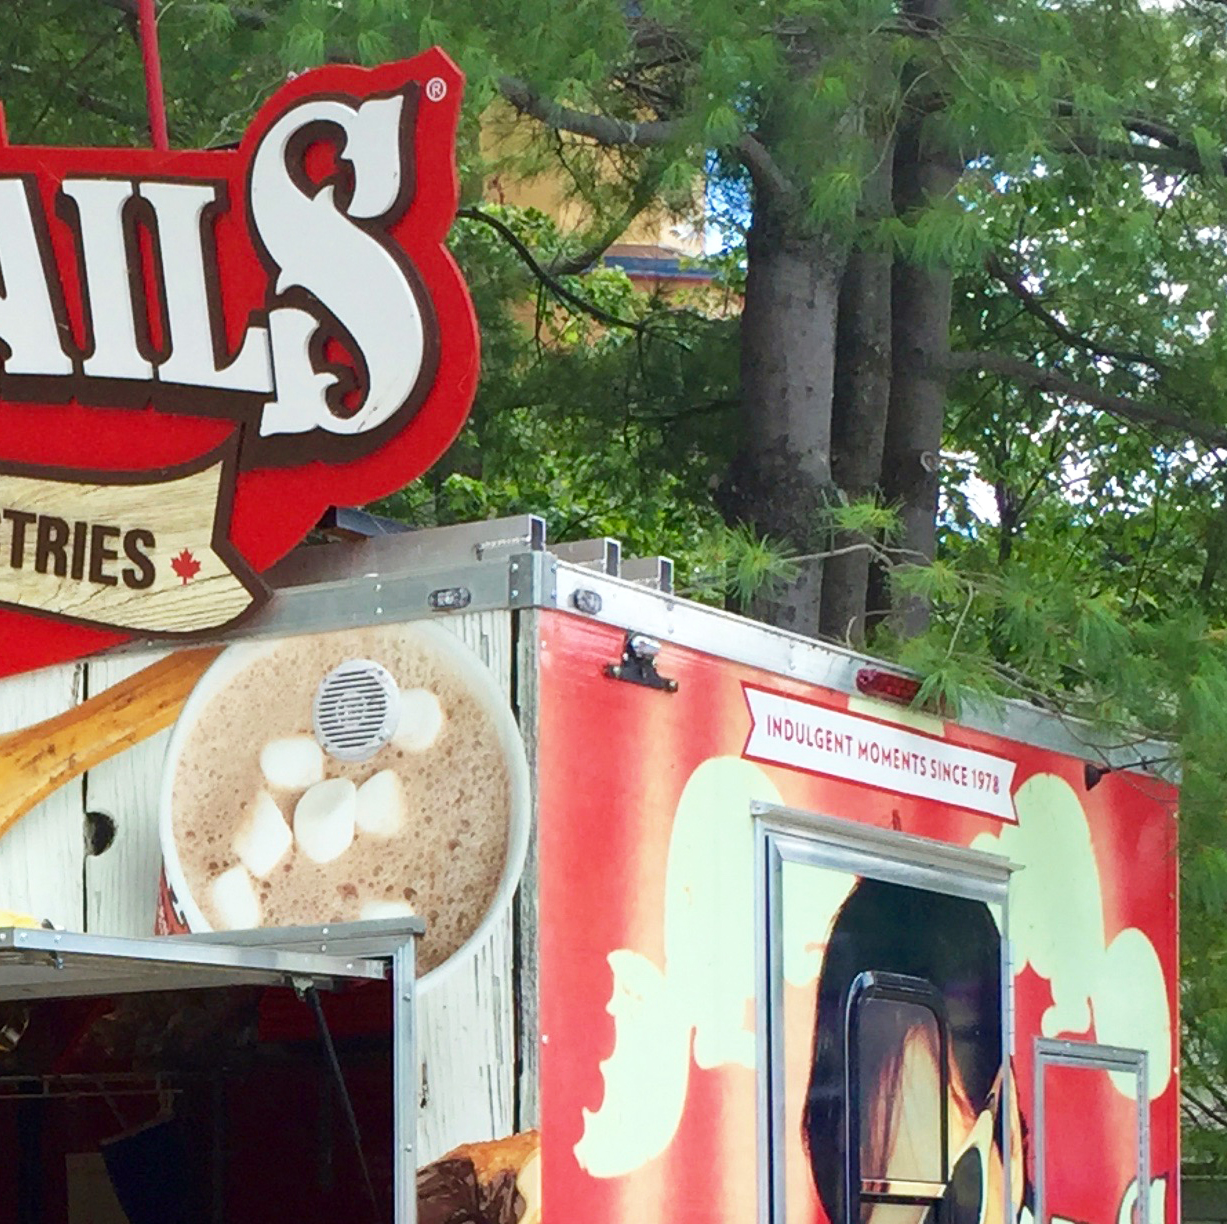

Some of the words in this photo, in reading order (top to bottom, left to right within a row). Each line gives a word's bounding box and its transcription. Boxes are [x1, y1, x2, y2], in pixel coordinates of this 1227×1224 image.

[766, 713, 853, 757] INDULGENT
[857, 738, 927, 777] MOMENTS
[930, 758, 968, 787] SINCE
[971, 769, 1000, 796] 1978
